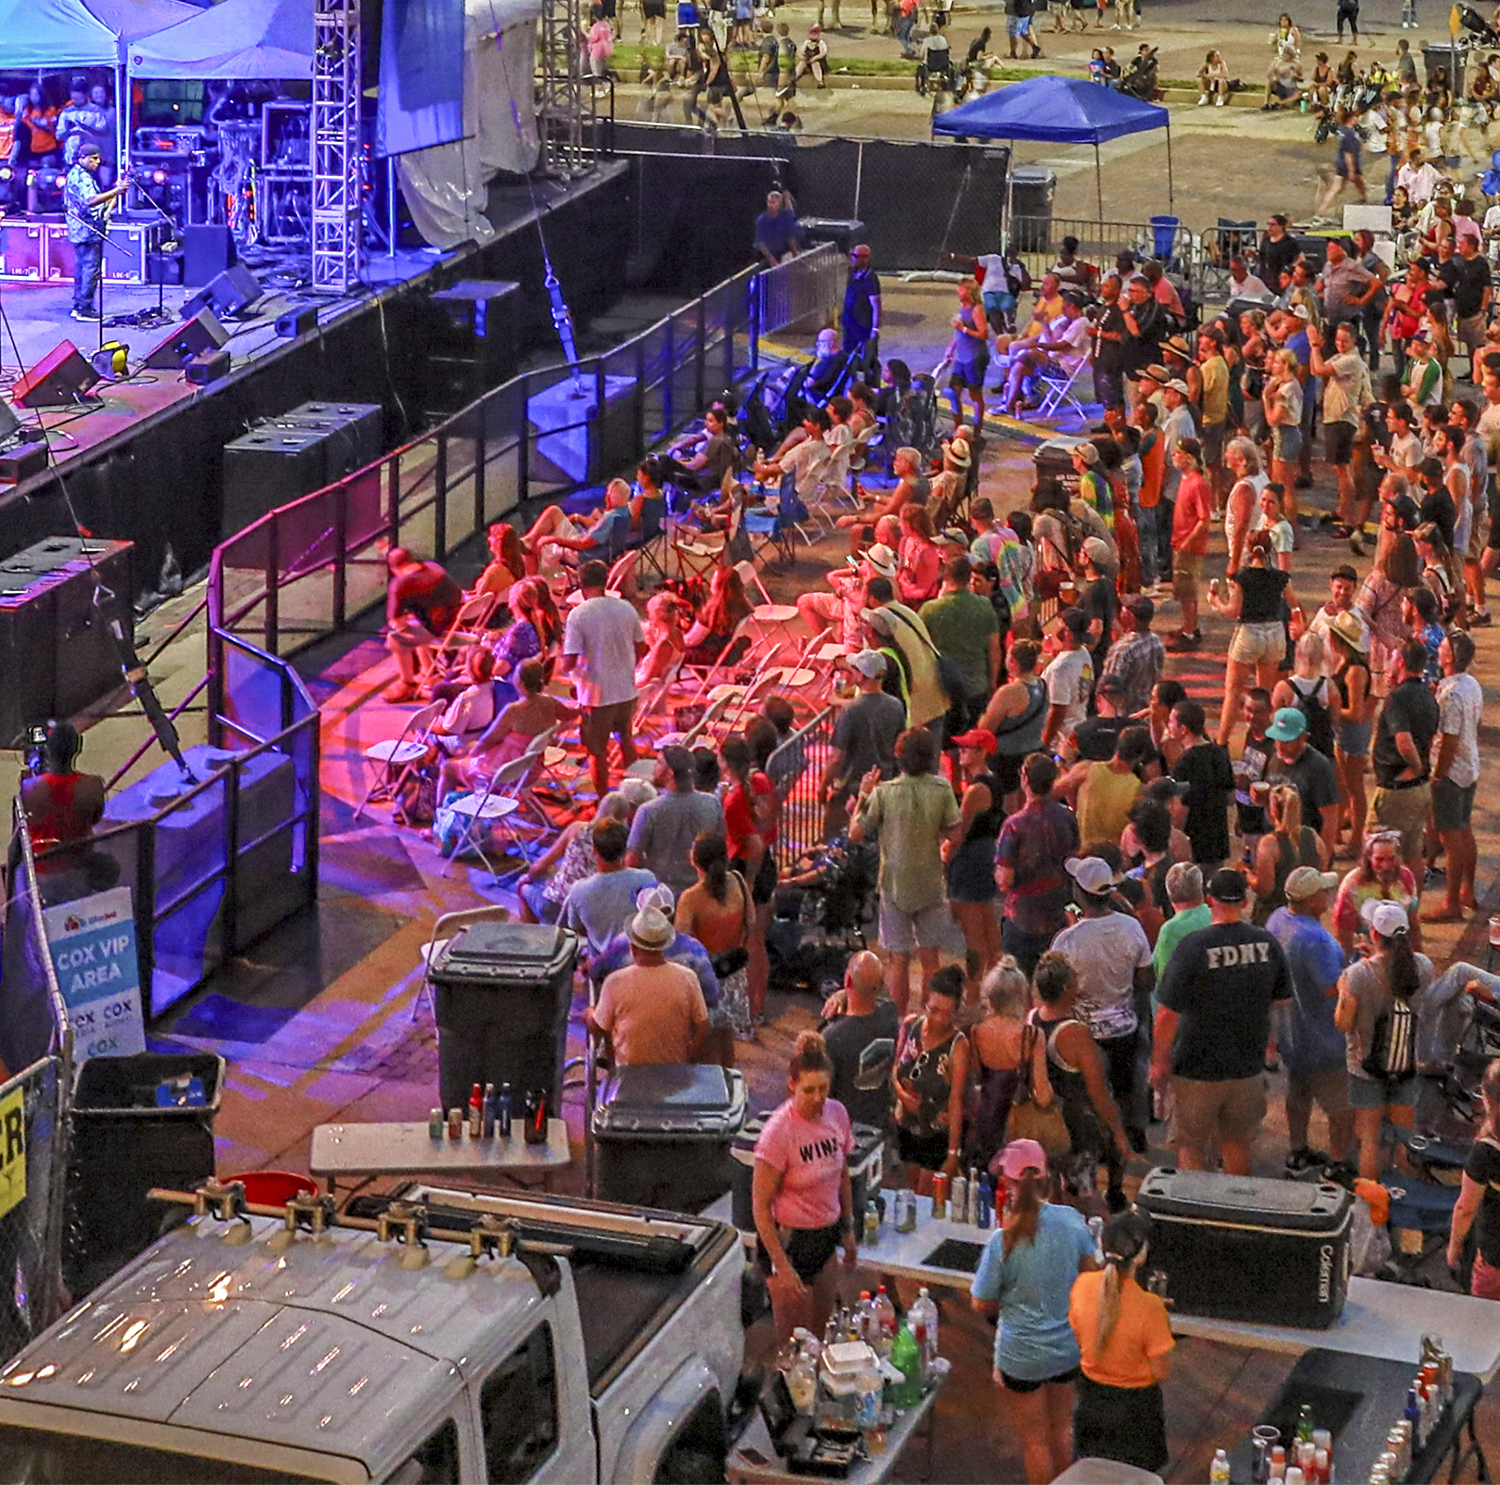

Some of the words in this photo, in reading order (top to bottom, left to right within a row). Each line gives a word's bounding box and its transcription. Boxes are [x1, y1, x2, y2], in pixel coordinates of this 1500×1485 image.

[56, 943, 97, 970] COX
[98, 935, 130, 960] VIP
[1206, 942, 1269, 969] FDNY
[70, 962, 122, 993] AREA
[103, 999, 132, 1020] COX
[87, 1036, 118, 1057] COX
[1319, 1245, 1334, 1302] Coleman
